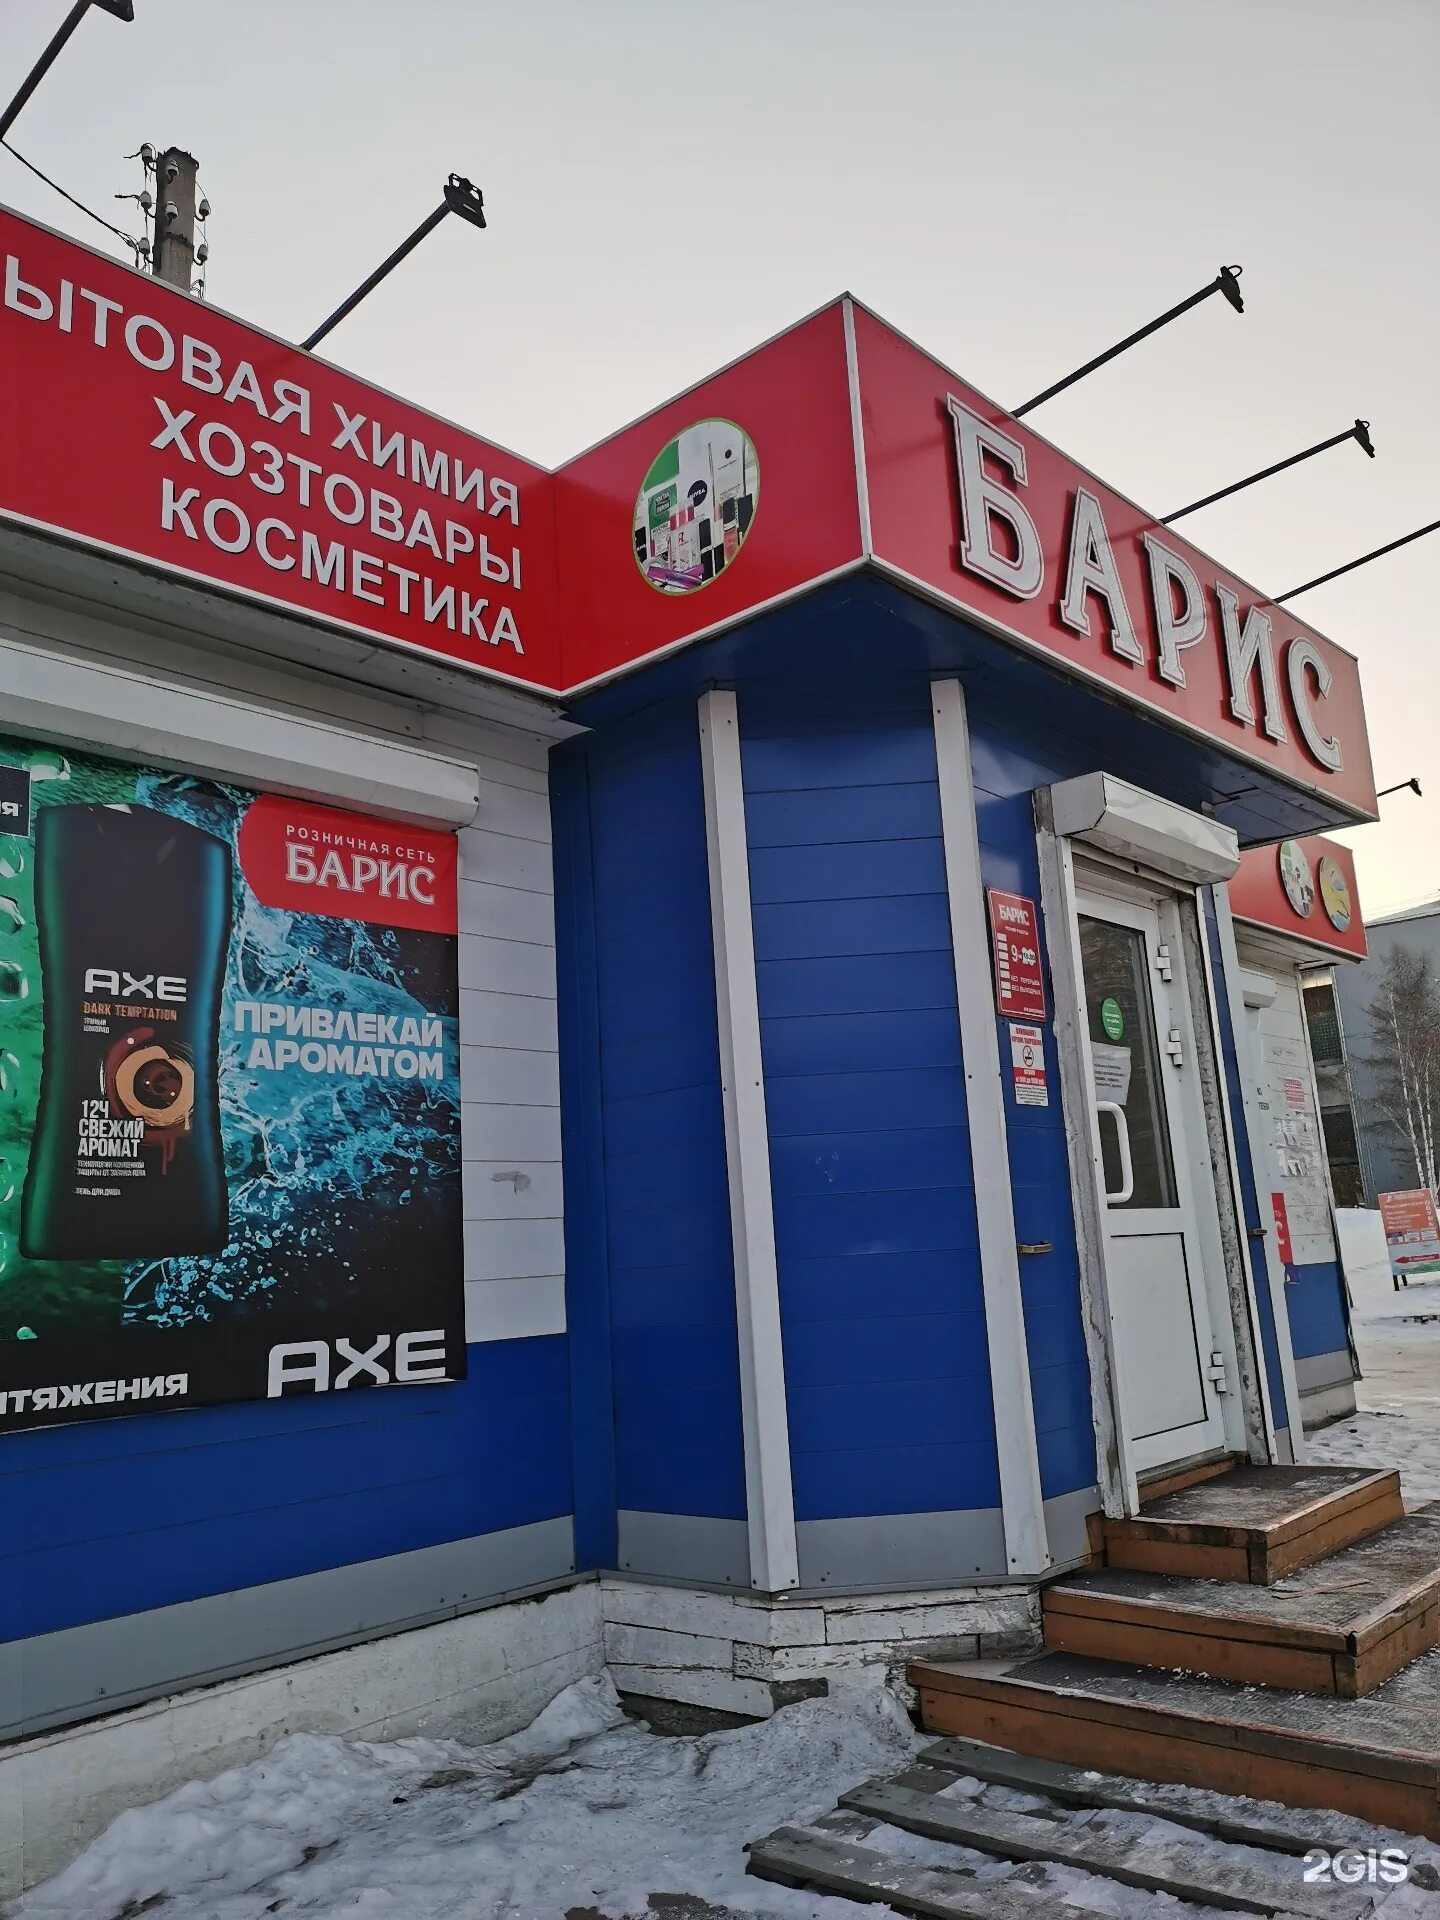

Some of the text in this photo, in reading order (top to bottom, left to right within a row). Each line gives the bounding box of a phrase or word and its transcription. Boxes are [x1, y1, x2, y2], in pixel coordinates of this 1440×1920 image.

[331, 402, 520, 526] ХИМИЯ
[150, 396, 522, 590] ХОЗТОВАРЫ
[161, 477, 525, 655] КОСМЕТИКА
[946, 391, 1344, 773] БАРИС
[286, 825, 436, 864] РОЗНИЧНАЯ СЕТЬ
[285, 841, 436, 905] БАРИС
[998, 903, 1031, 926] БАРИС
[84, 968, 187, 1003] AXE
[83, 1001, 178, 1021] DARK TEMPTATION
[234, 1000, 444, 1048] ПРИВЛЕКАЙ
[247, 1039, 444, 1080] АРОМАТОМ
[77, 1137, 141, 1158] АРОМАТ
[78, 1117, 145, 1139] СВЕЖИЙ
[266, 1329, 446, 1399] AXE
